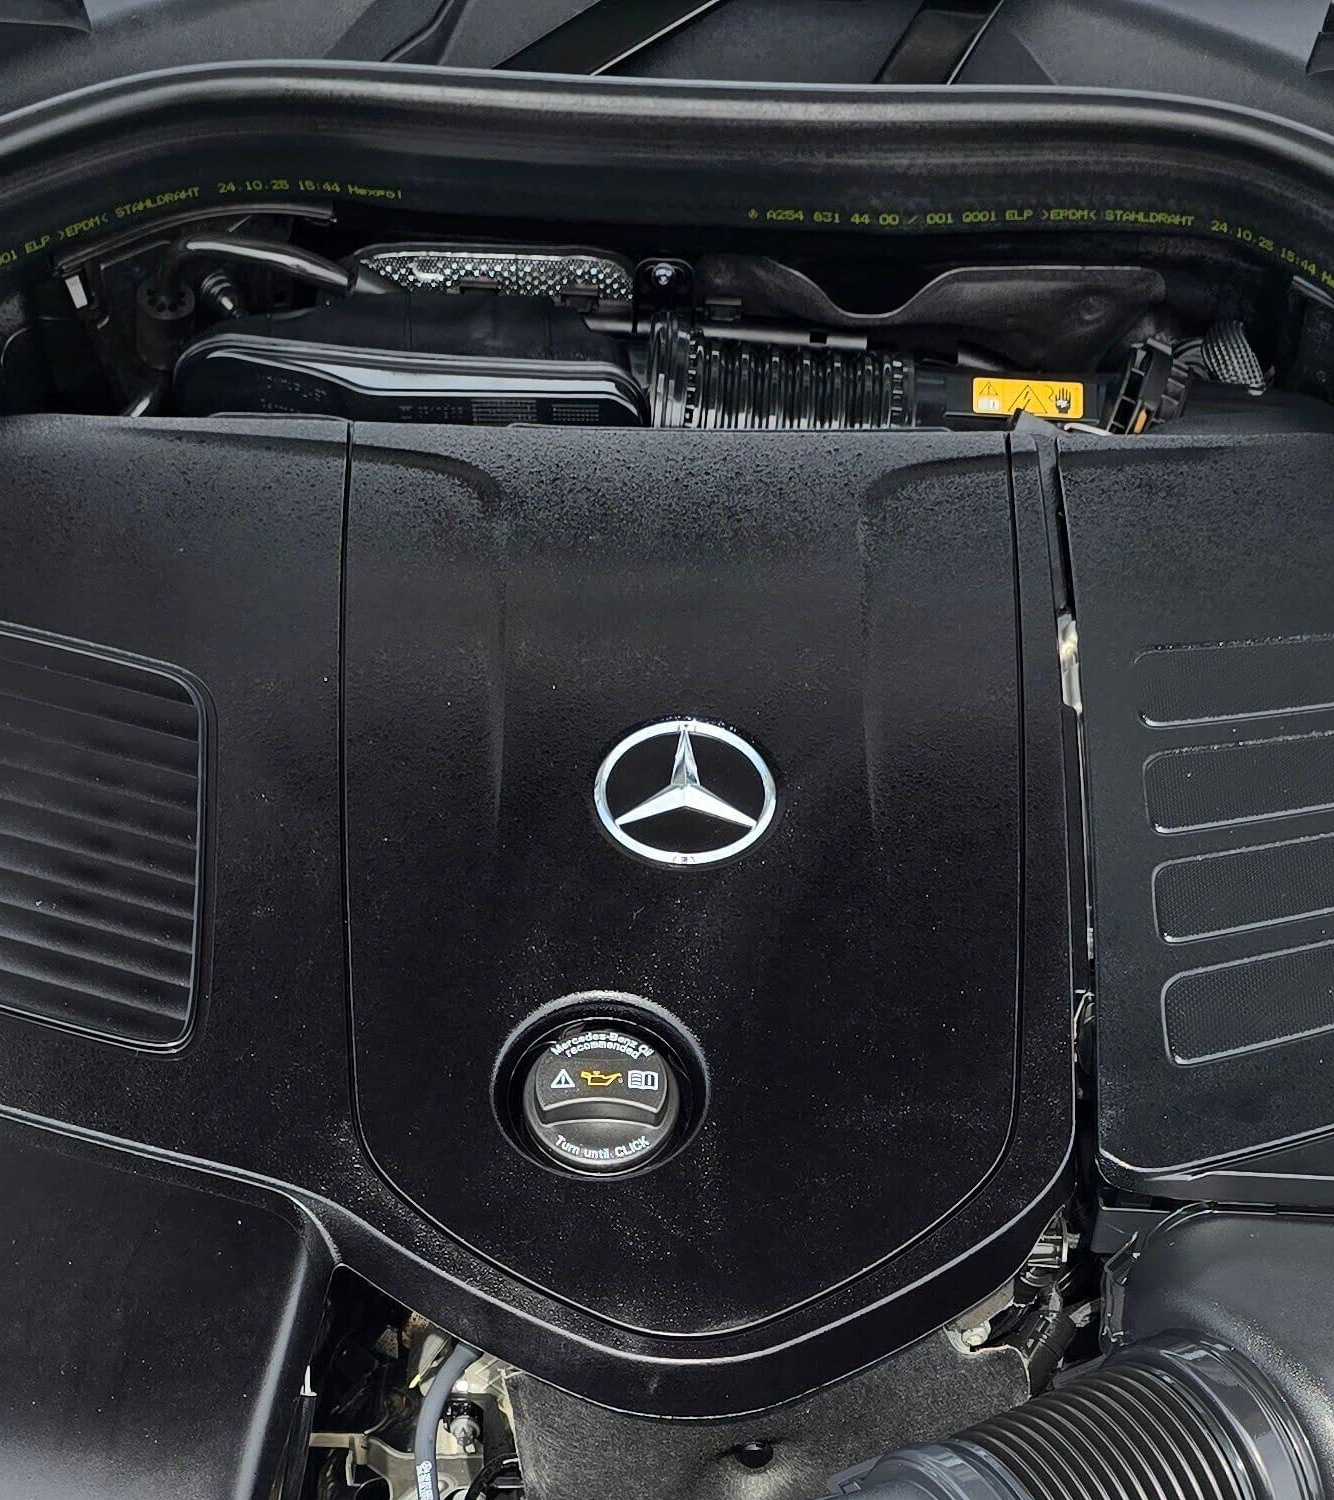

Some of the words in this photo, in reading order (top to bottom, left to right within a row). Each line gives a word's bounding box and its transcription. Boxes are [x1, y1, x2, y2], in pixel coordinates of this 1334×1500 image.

[115, 187, 200, 218] STAHLDRAHT
[851, 213, 871, 224] 44
[879, 213, 899, 225] 00
[927, 212, 953, 224] 001
[1104, 210, 1195, 226] STAHLDRAHT
[550, 1032, 638, 1056] Mercedes-Benz
[565, 1040, 640, 1060] recommended
[555, 1134, 580, 1155] Turn
[584, 1148, 610, 1159] until
[614, 1135, 650, 1157] CLICK
